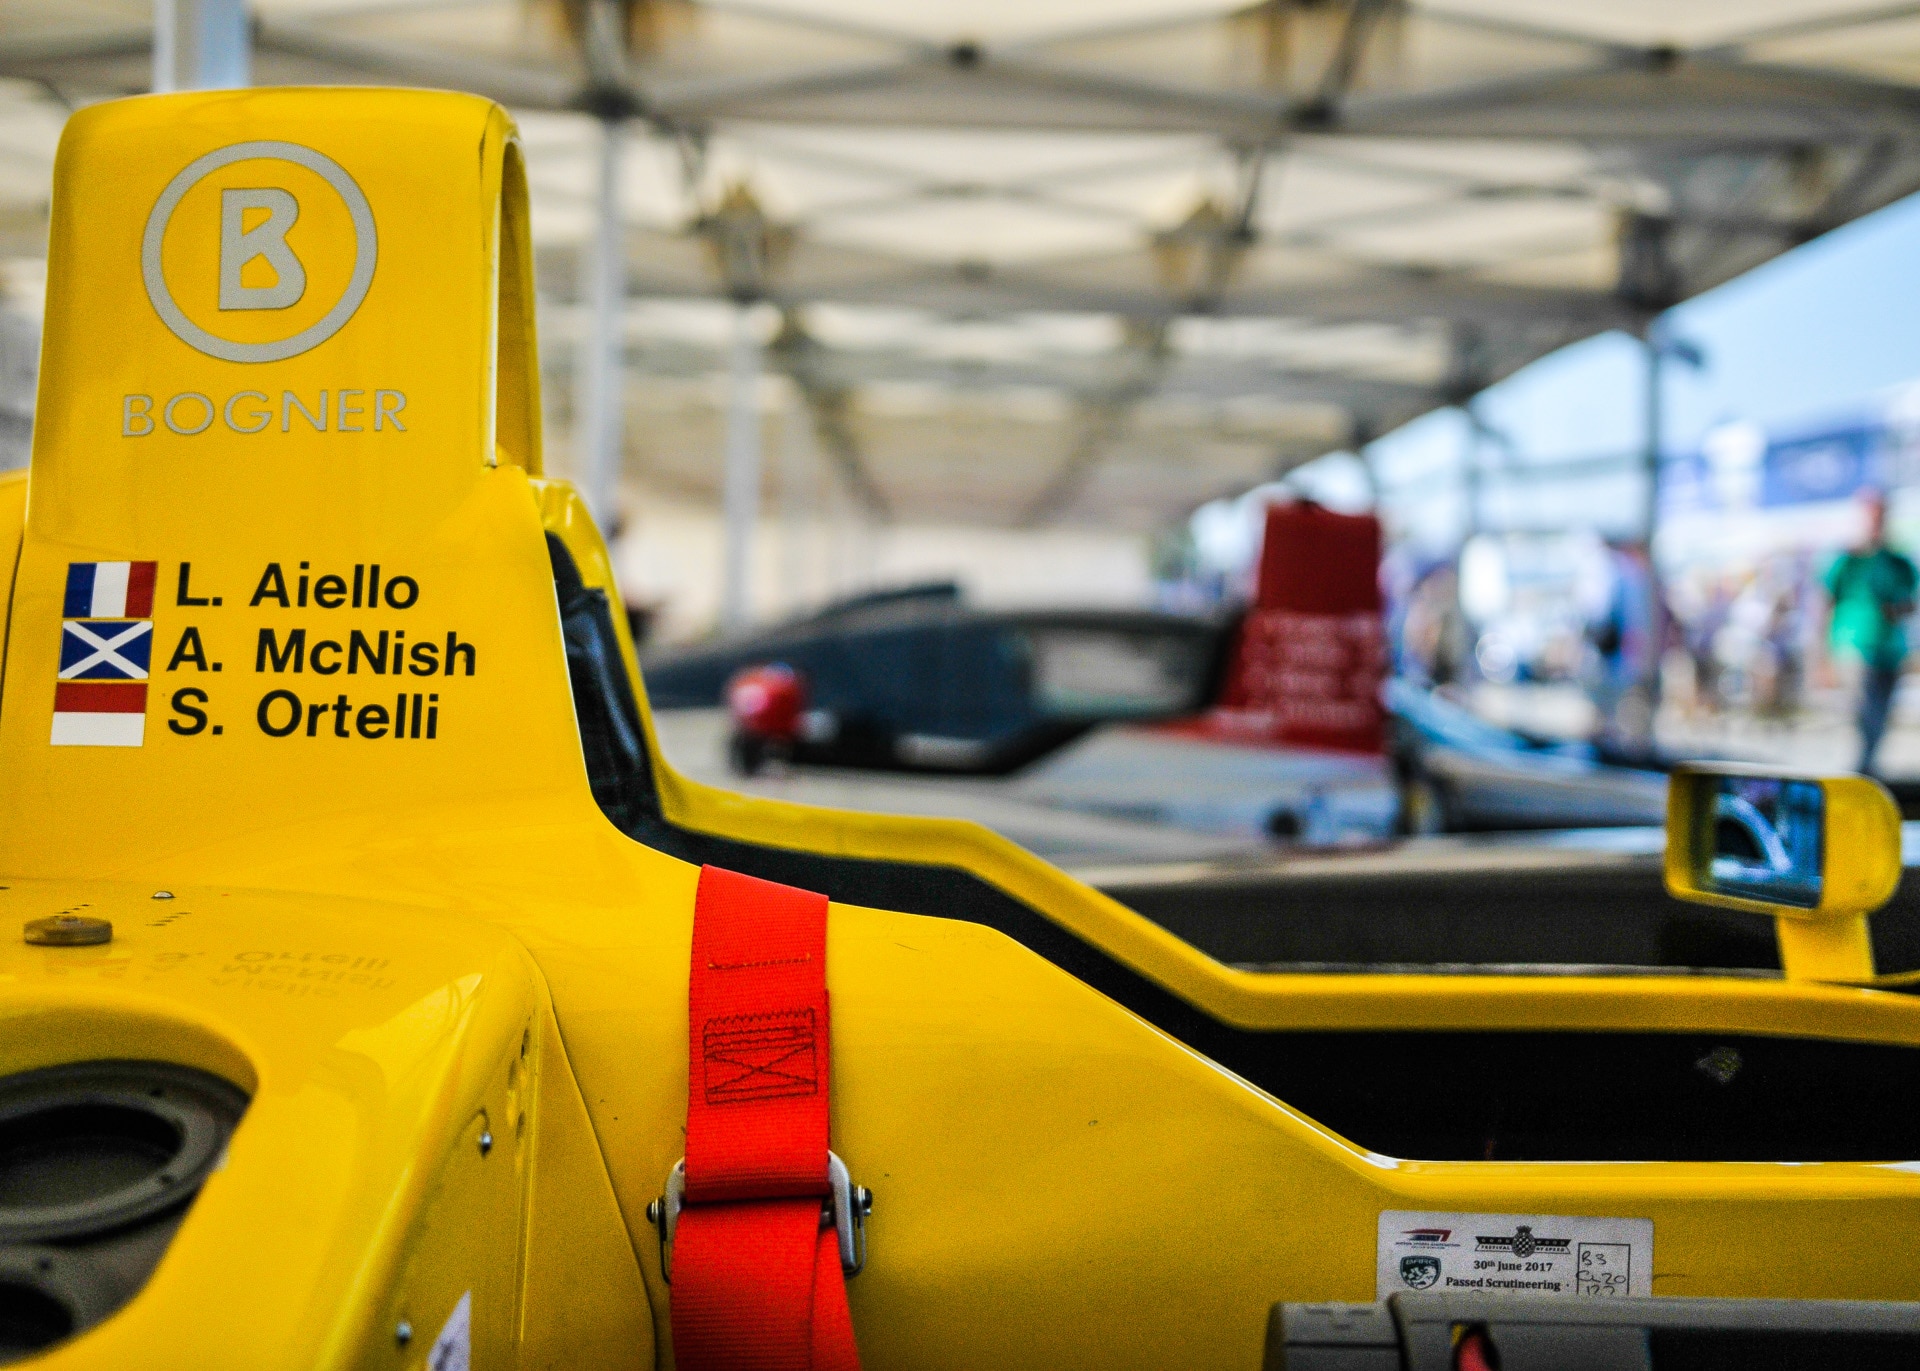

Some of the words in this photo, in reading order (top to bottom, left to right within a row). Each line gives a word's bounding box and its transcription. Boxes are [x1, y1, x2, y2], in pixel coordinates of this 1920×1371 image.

[218, 187, 307, 311] B
[122, 389, 407, 437] BOGNER
[175, 561, 223, 607] L.
[249, 561, 420, 609] Aiello
[166, 626, 223, 672] A.
[254, 627, 476, 676] McNish
[167, 687, 224, 735] S.
[256, 688, 439, 739] Ortelli
[1446, 1277, 1483, 1288] Passed
[1485, 1279, 1561, 1292] Scrutineering
[1473, 1260, 1496, 1270] 30th
[1497, 1261, 1522, 1272] June
[1525, 1262, 1553, 1272] 2017
